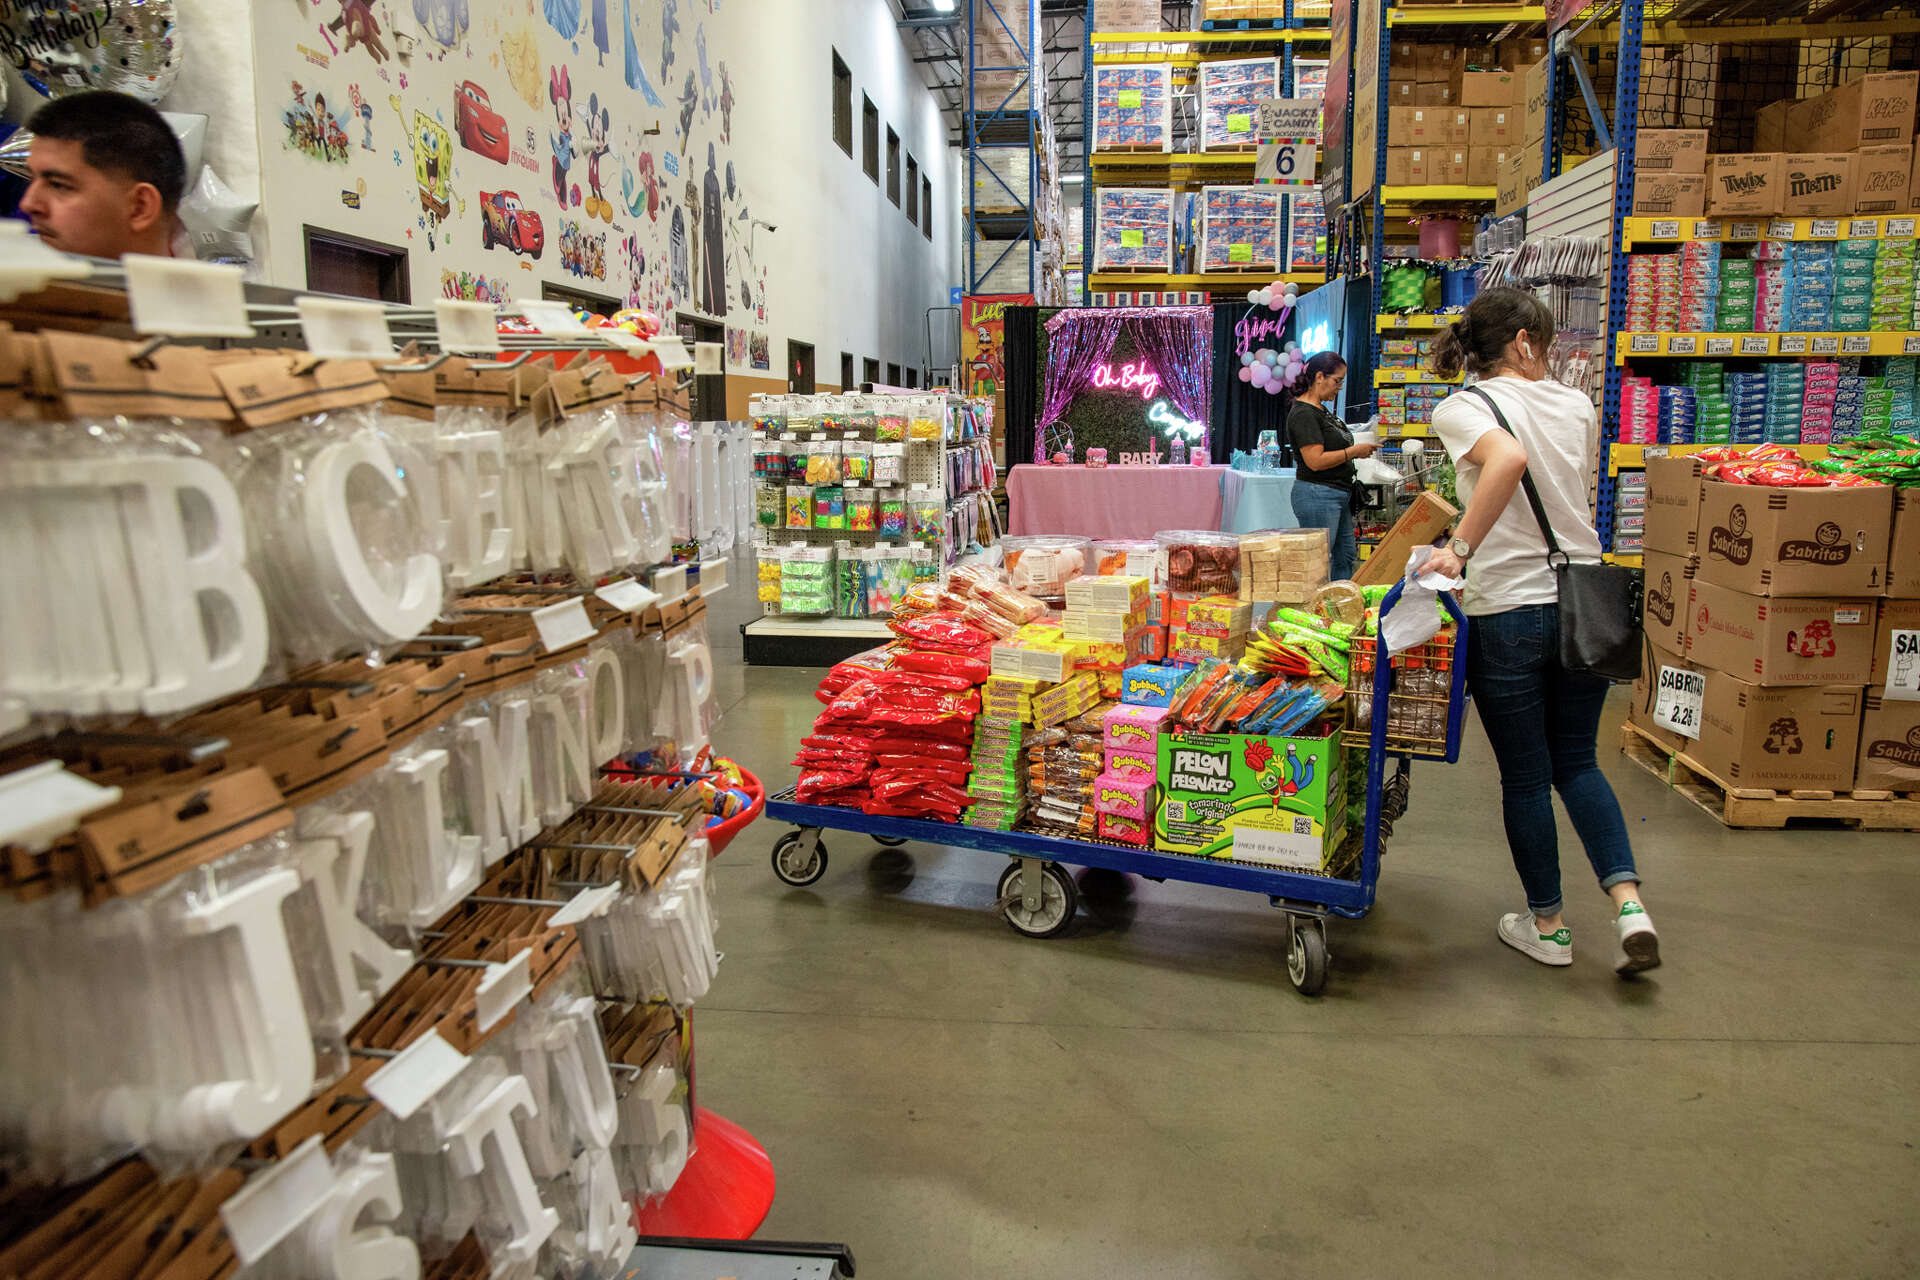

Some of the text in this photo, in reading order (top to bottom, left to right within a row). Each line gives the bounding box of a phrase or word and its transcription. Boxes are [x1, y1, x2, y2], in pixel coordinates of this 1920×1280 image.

[1274, 107, 1318, 118] JACK'S
[1273, 119, 1317, 128] CANDY
[1276, 146, 1296, 175] 6
[1720, 170, 1768, 194] Twix
[1093, 359, 1160, 399] Oh Baby
[1119, 452, 1164, 466] BABY
[1712, 531, 1749, 559] Sabritas
[1786, 544, 1845, 561] Sabritas
[1896, 634, 1920, 654] SA
[1129, 679, 1166, 698] Bubbaloo
[1661, 670, 1704, 697] SABRITAS
[1670, 706, 1693, 727] 2.25
[1112, 724, 1152, 741] Bubbaloo
[1112, 756, 1152, 773] Bubbaloo
[1174, 751, 1228, 776] PELON
[1171, 774, 1234, 792] PELONAZO
[1101, 789, 1138, 808] Bubbaloo
[1188, 798, 1236, 814] tamarindo
[1105, 814, 1140, 832] Bubbaloo
[1196, 808, 1226, 820] original
